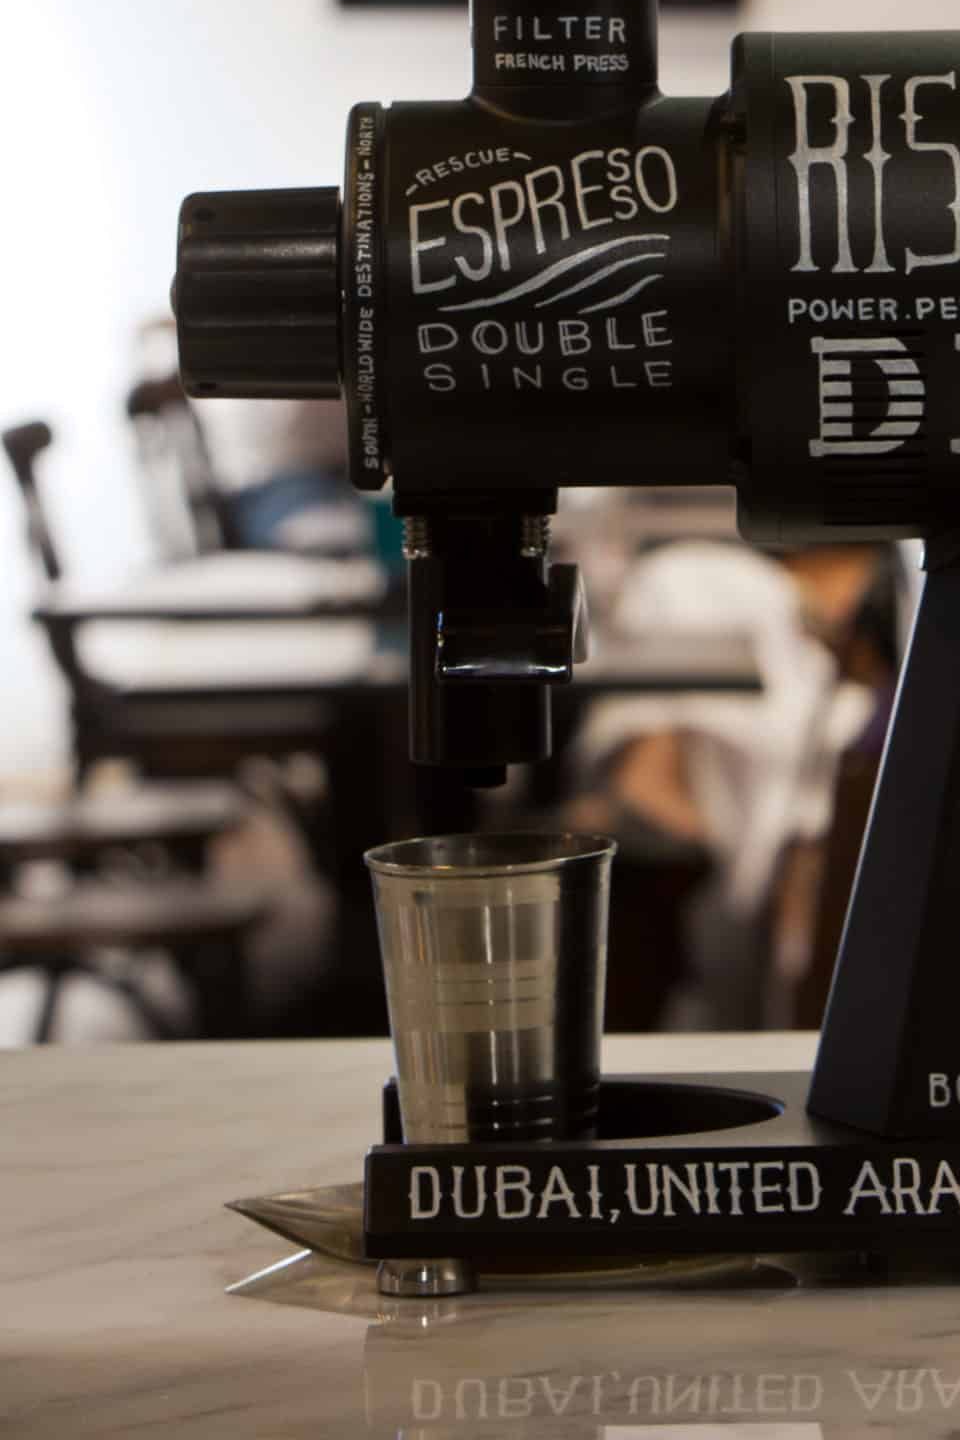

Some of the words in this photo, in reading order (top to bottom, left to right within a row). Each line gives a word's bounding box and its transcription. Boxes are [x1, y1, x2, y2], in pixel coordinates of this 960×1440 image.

[493, 15, 626, 43] FILTER
[495, 53, 565, 72] FRENCH
[573, 54, 629, 72] PRESS
[409, 145, 678, 295] ESPRESSO
[417, 310, 673, 356] DOUBLE
[423, 360, 673, 391] SINGLE
